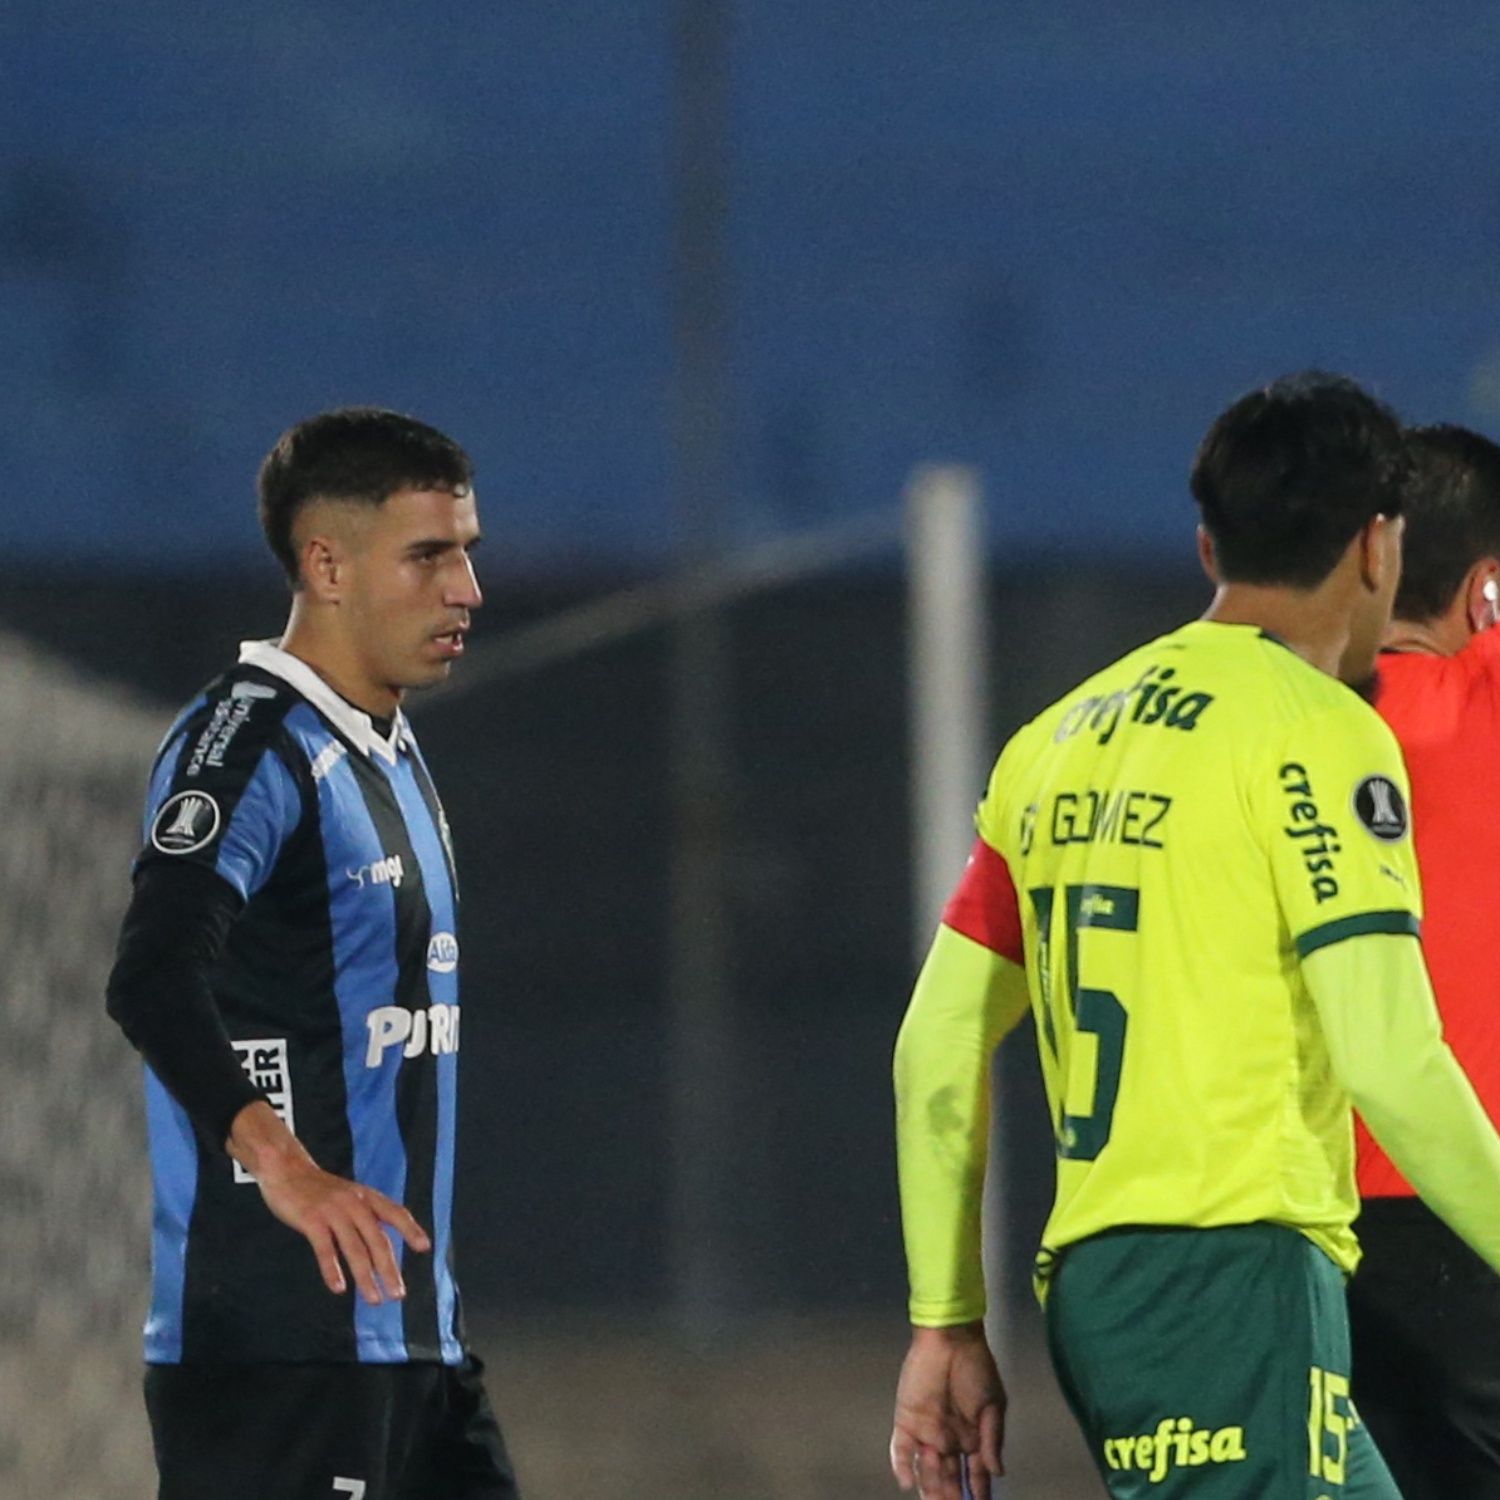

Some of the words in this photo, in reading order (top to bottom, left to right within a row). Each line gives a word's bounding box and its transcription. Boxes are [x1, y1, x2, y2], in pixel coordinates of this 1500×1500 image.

[1279, 761, 1342, 905] crefisa
[1103, 1417, 1247, 1483] crefisa
[1308, 1365, 1350, 1486] 15
